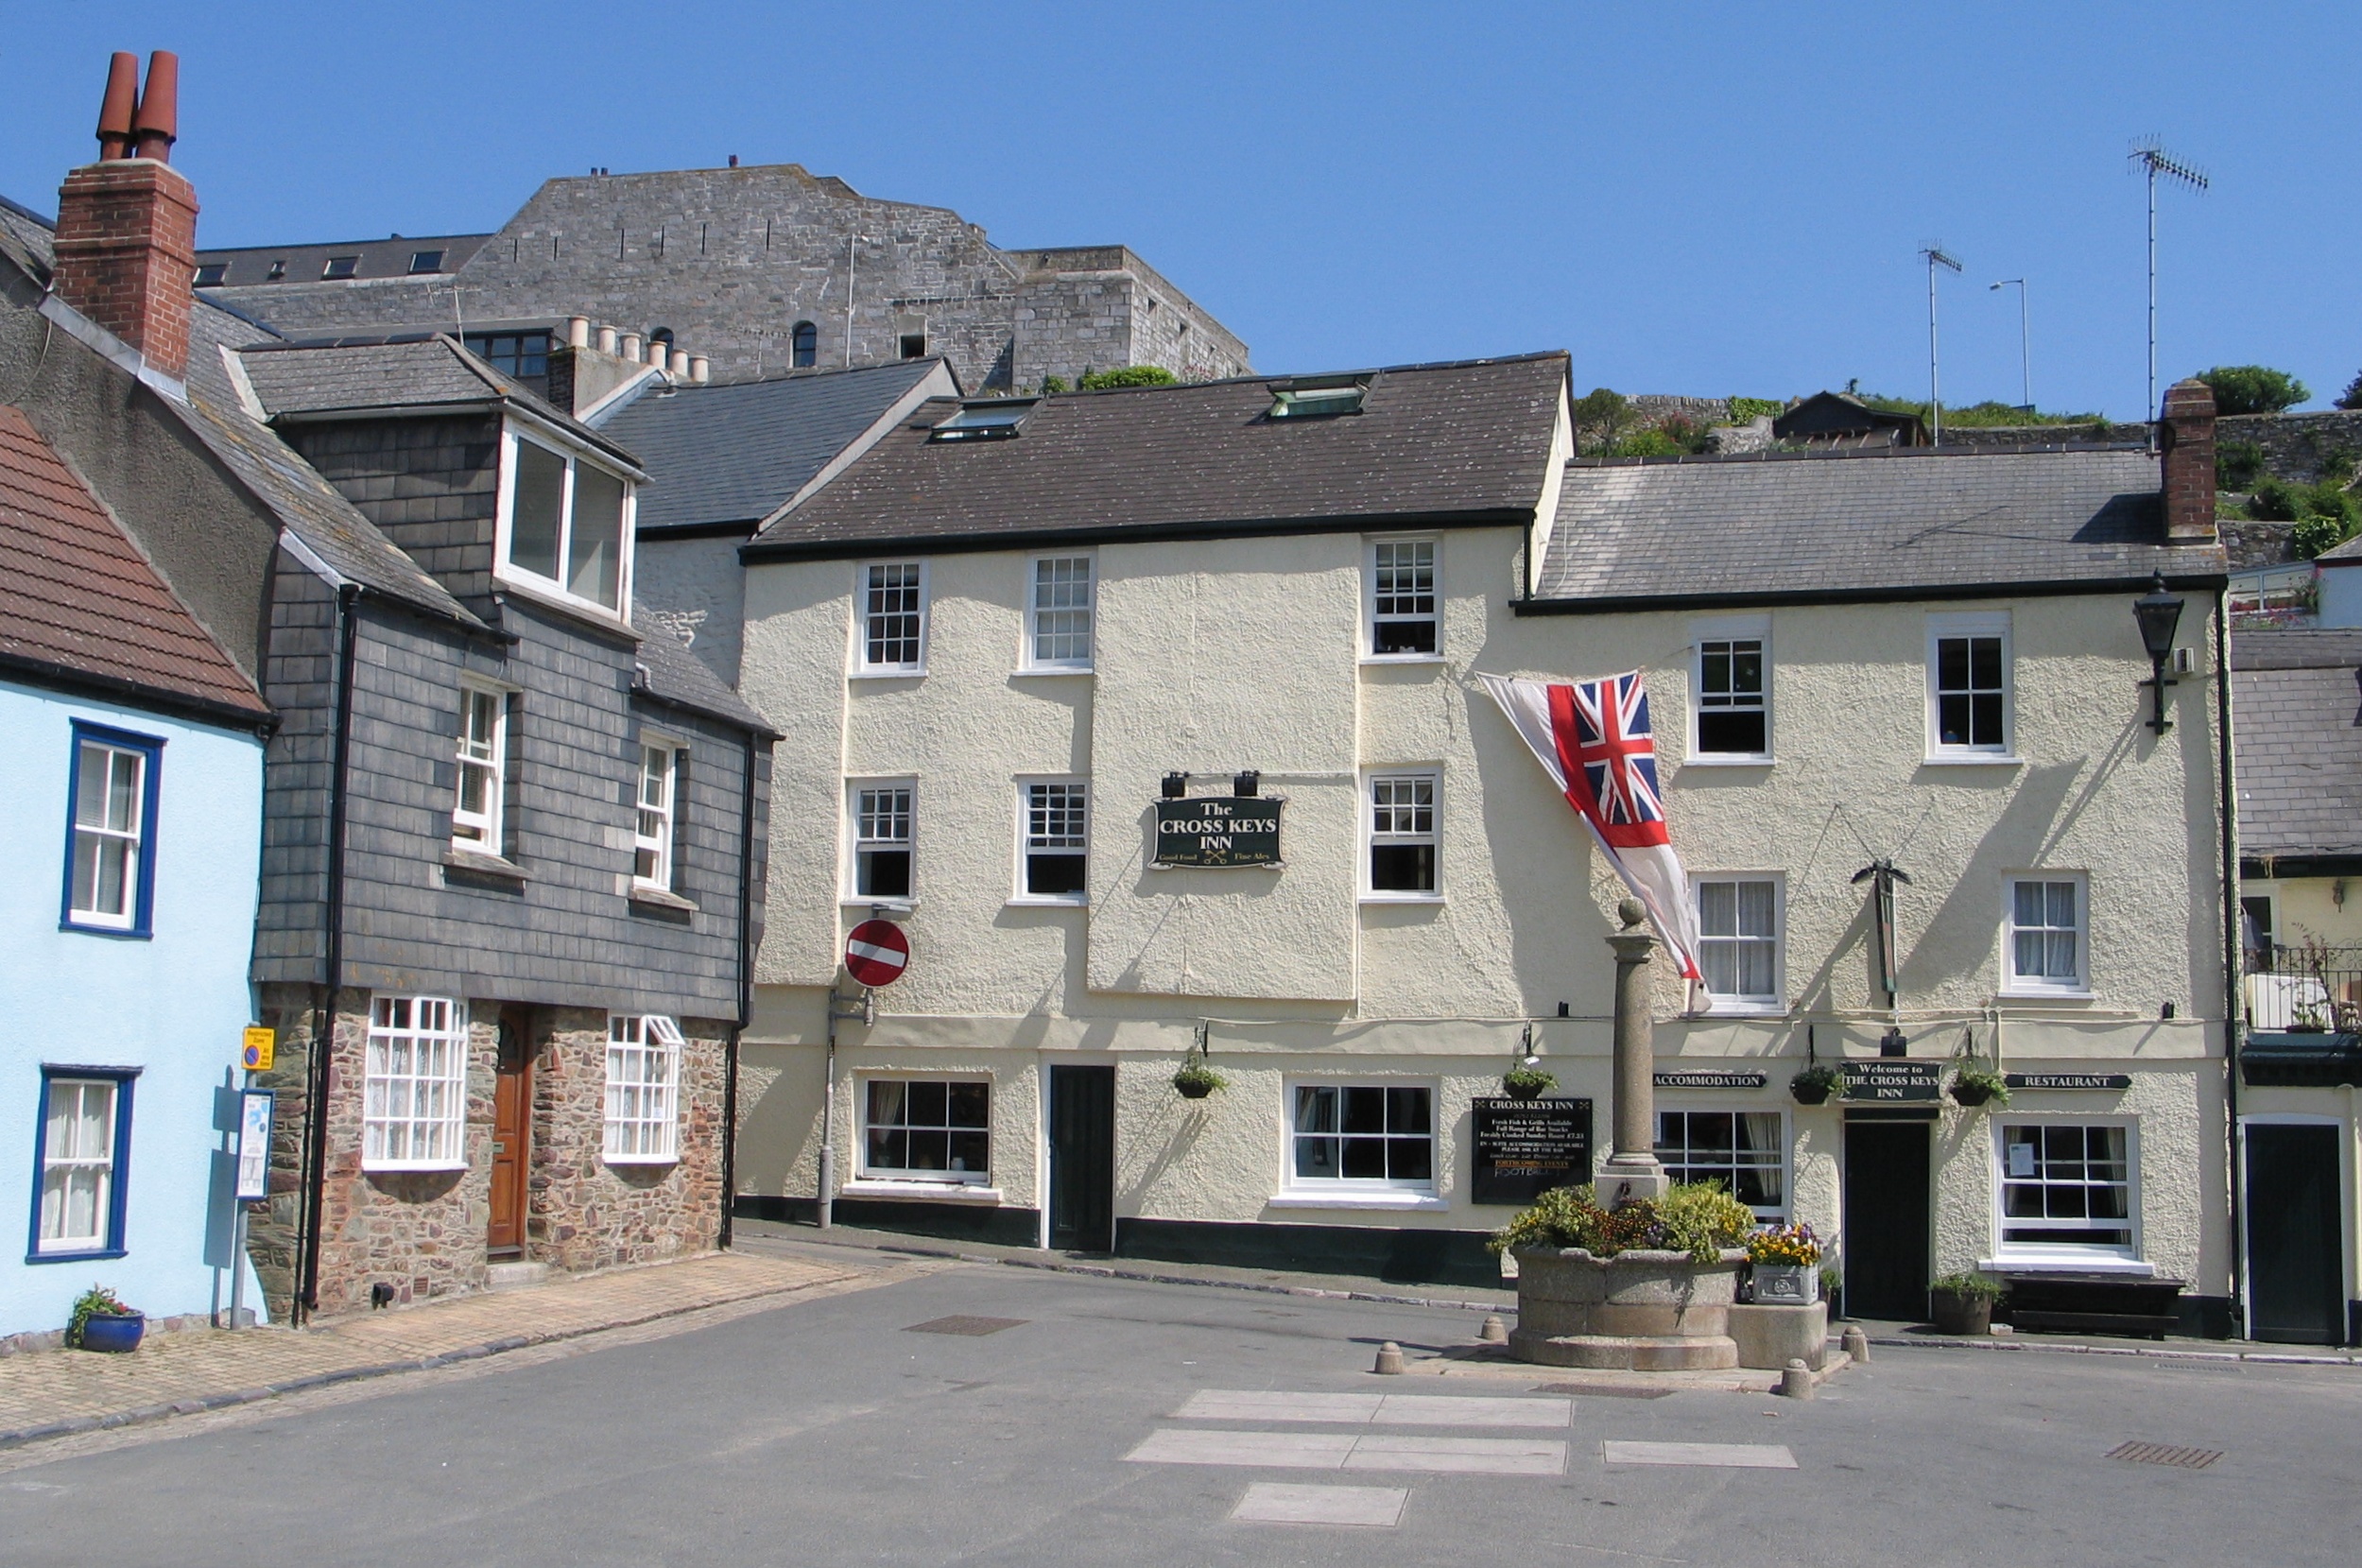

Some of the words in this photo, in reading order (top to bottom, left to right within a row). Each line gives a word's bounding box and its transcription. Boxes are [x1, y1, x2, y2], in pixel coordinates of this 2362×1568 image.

[1200, 802, 1233, 816] The
[1160, 819, 1224, 834] CROSS
[1229, 818, 1277, 833] KEYS
[1199, 836, 1233, 850] INN
[1858, 1064, 1908, 1074] Welcome
[1912, 1065, 1923, 1074] to
[1654, 1076, 1759, 1086] ACCOMMODATION
[1843, 1076, 1868, 1085] THE
[1870, 1076, 1908, 1086] CROSS
[1910, 1077, 1938, 1086] KEYS
[2025, 1077, 2110, 1086] RESTAURANT
[1877, 1088, 1904, 1097] INN
[1490, 1100, 1524, 1110] CROSS
[1526, 1100, 1553, 1111] KEYS
[1555, 1101, 1574, 1111] INN
